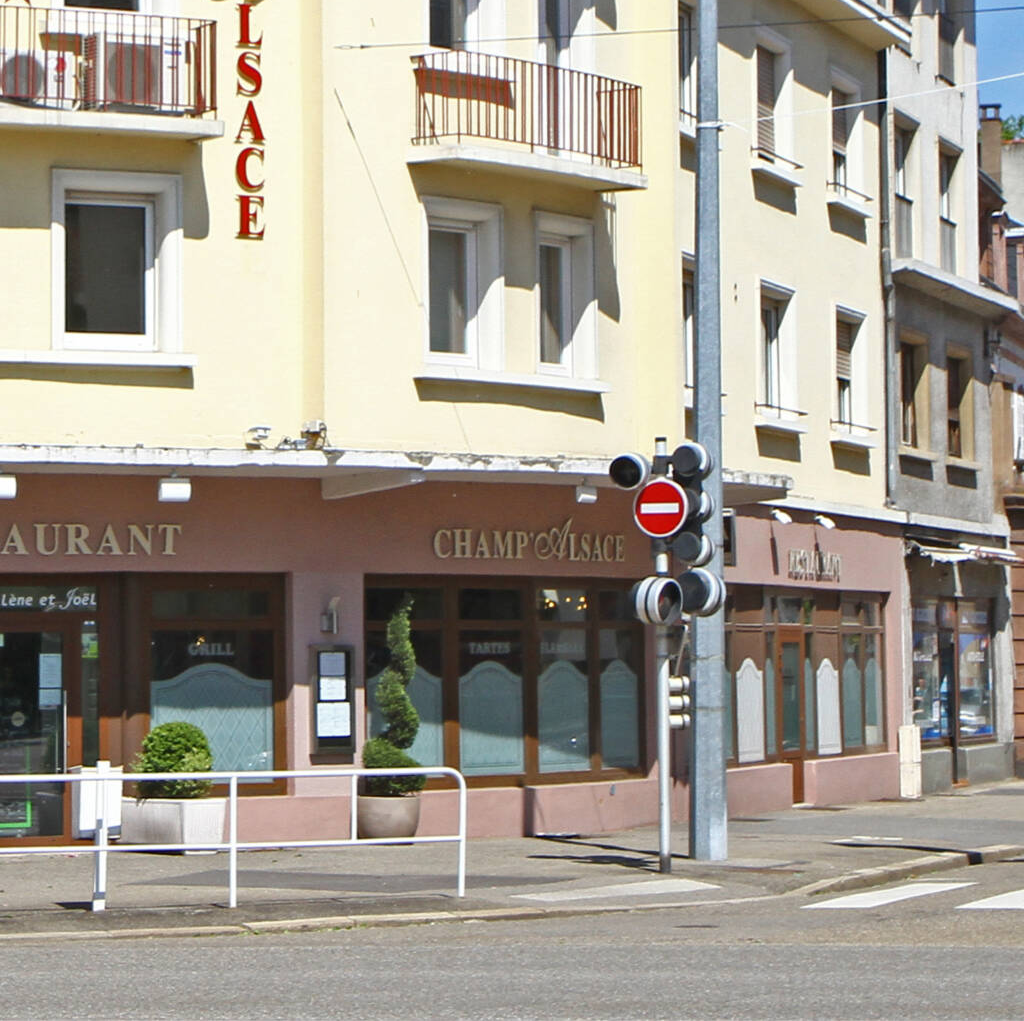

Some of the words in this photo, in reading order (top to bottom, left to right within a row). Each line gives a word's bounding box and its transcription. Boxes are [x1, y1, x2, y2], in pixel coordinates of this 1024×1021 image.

[39, 594, 55, 606] et
[188, 642, 235, 656] GRILL
[469, 642, 511, 655] TARTES
